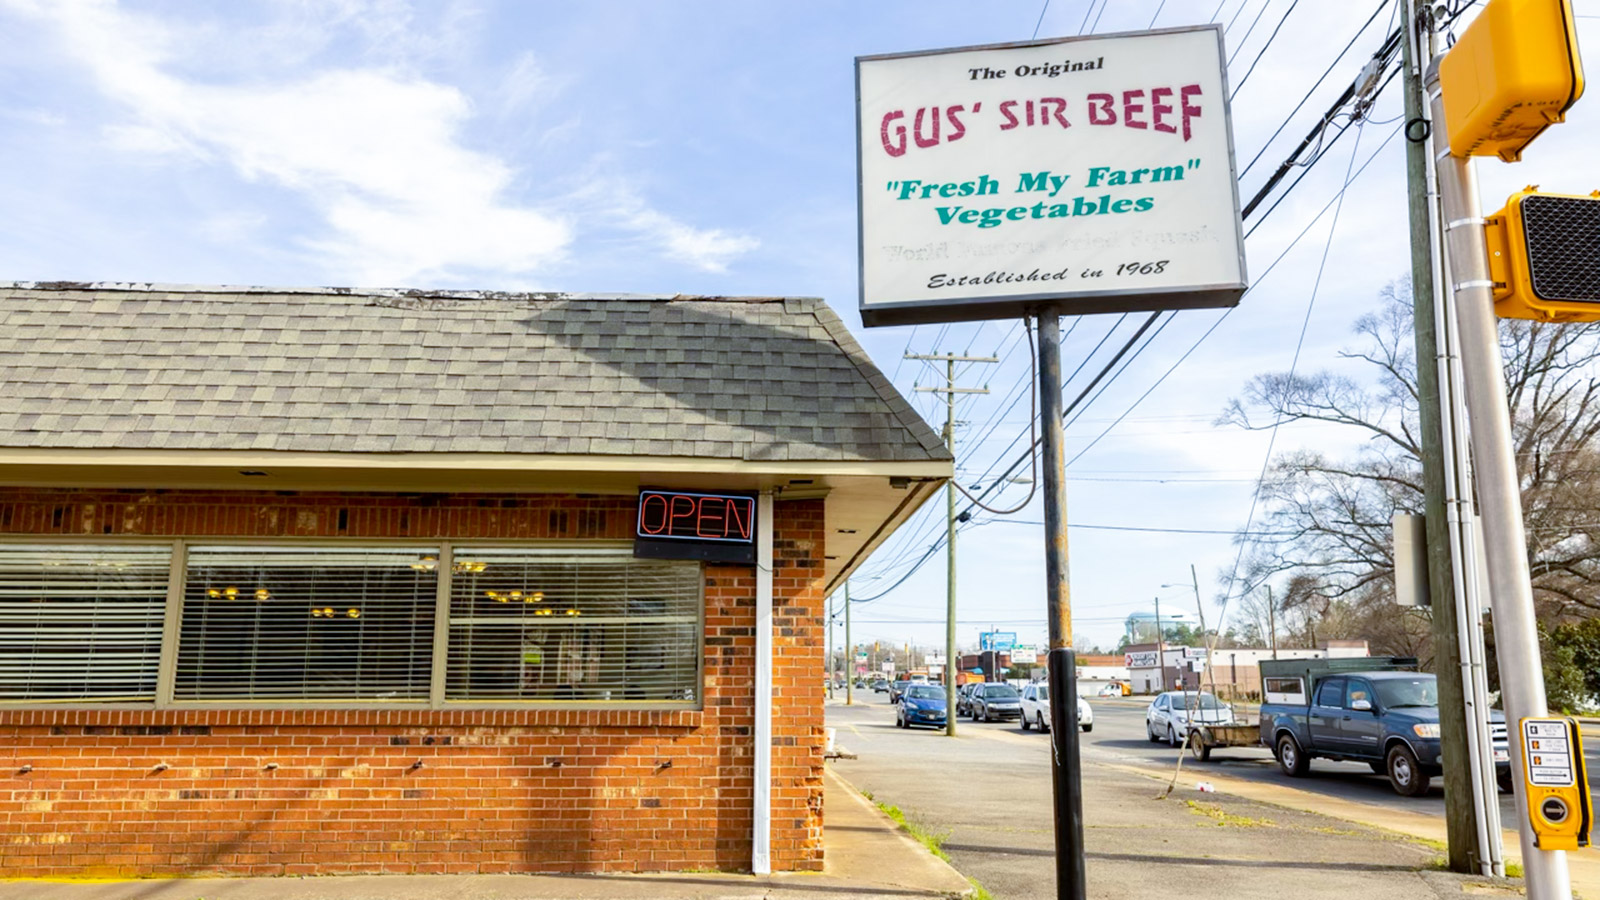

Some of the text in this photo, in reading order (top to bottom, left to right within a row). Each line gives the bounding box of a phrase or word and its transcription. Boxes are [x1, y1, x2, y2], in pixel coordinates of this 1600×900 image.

[968, 56, 1104, 81] The Original
[880, 84, 1203, 157] GUS' SIR BEEF
[886, 158, 1202, 201] "Fresh My Farm"
[934, 193, 1156, 229] Vegetables
[926, 259, 1170, 289] Established in 1968
[641, 494, 752, 539] OPEN
